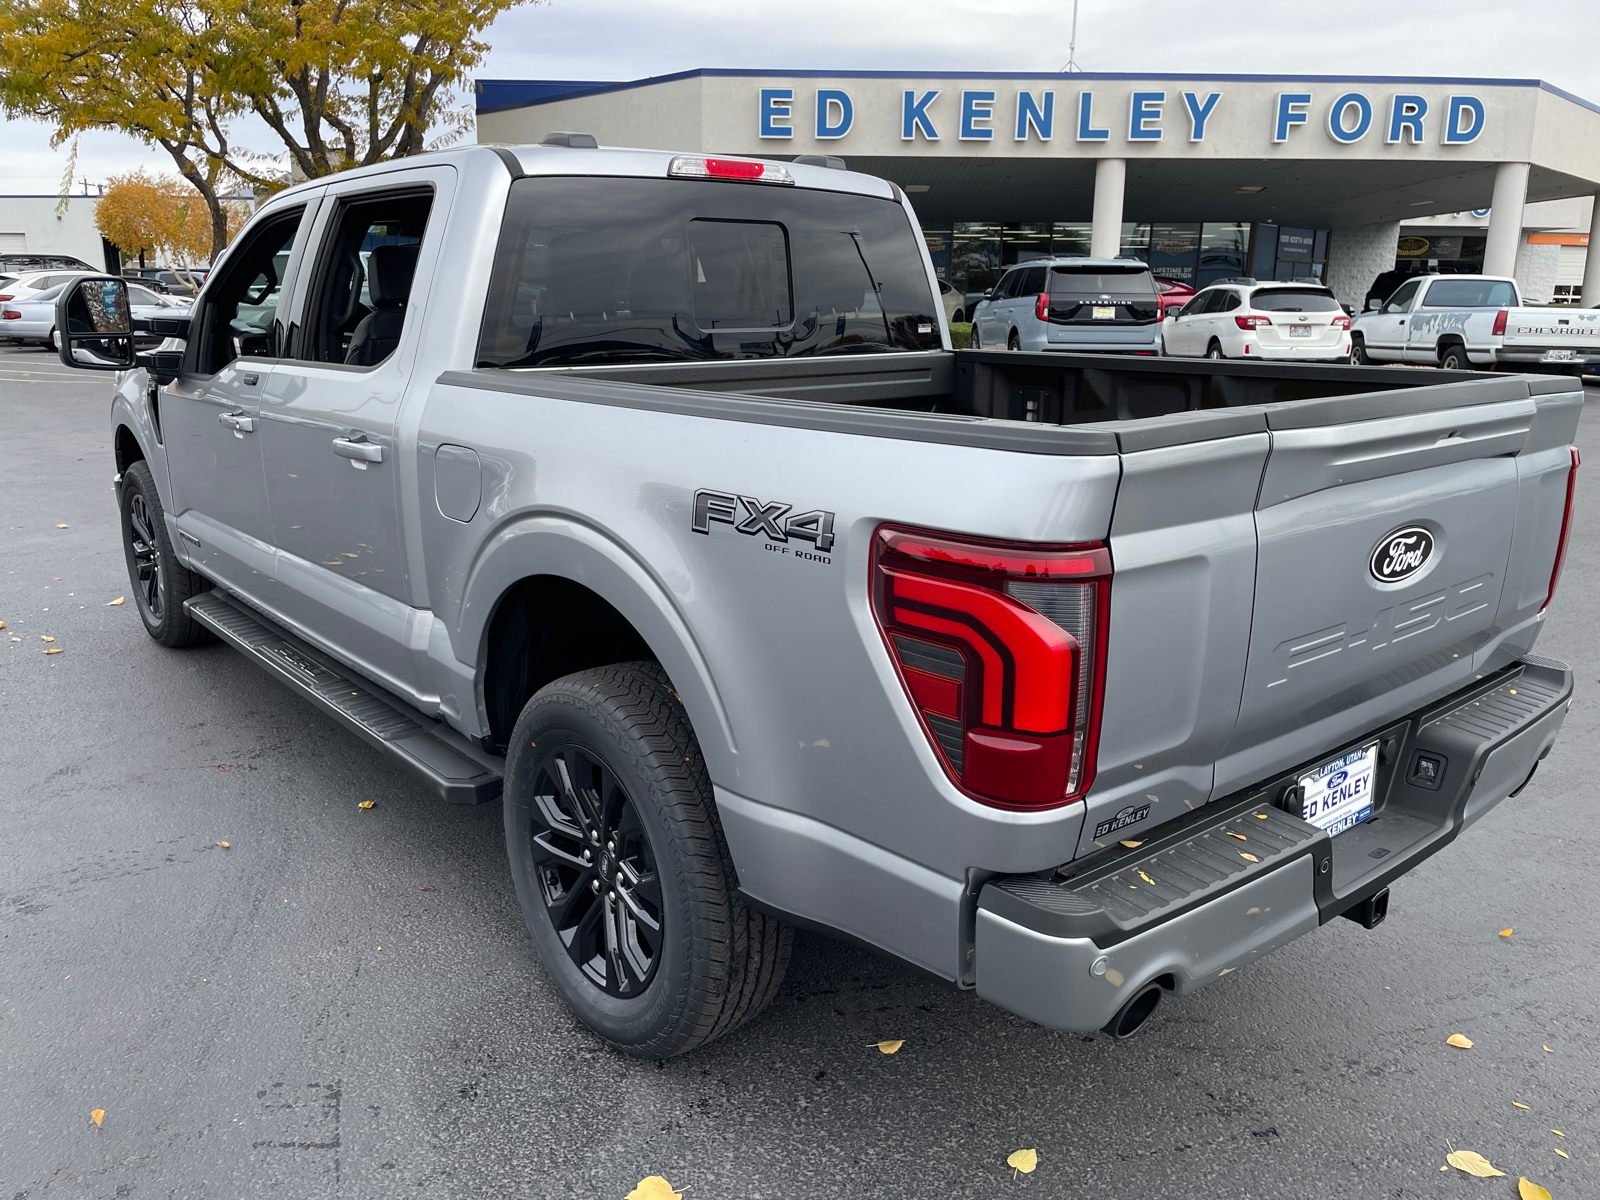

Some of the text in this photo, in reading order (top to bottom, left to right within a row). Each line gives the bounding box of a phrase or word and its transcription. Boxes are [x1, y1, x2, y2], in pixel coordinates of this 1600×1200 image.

[759, 88, 1486, 146] ED KENLEY FORD
[1517, 326, 1600, 335] CHEVROLE
[691, 487, 836, 553] FX4
[764, 543, 831, 565] OFF ROAD
[1383, 535, 1427, 576] Ford
[1266, 571, 1495, 688] F-150
[1320, 749, 1363, 777] LAYTON, UTAH
[1322, 773, 1370, 812] KENLEY
[1096, 807, 1150, 837] ED KENLEY
